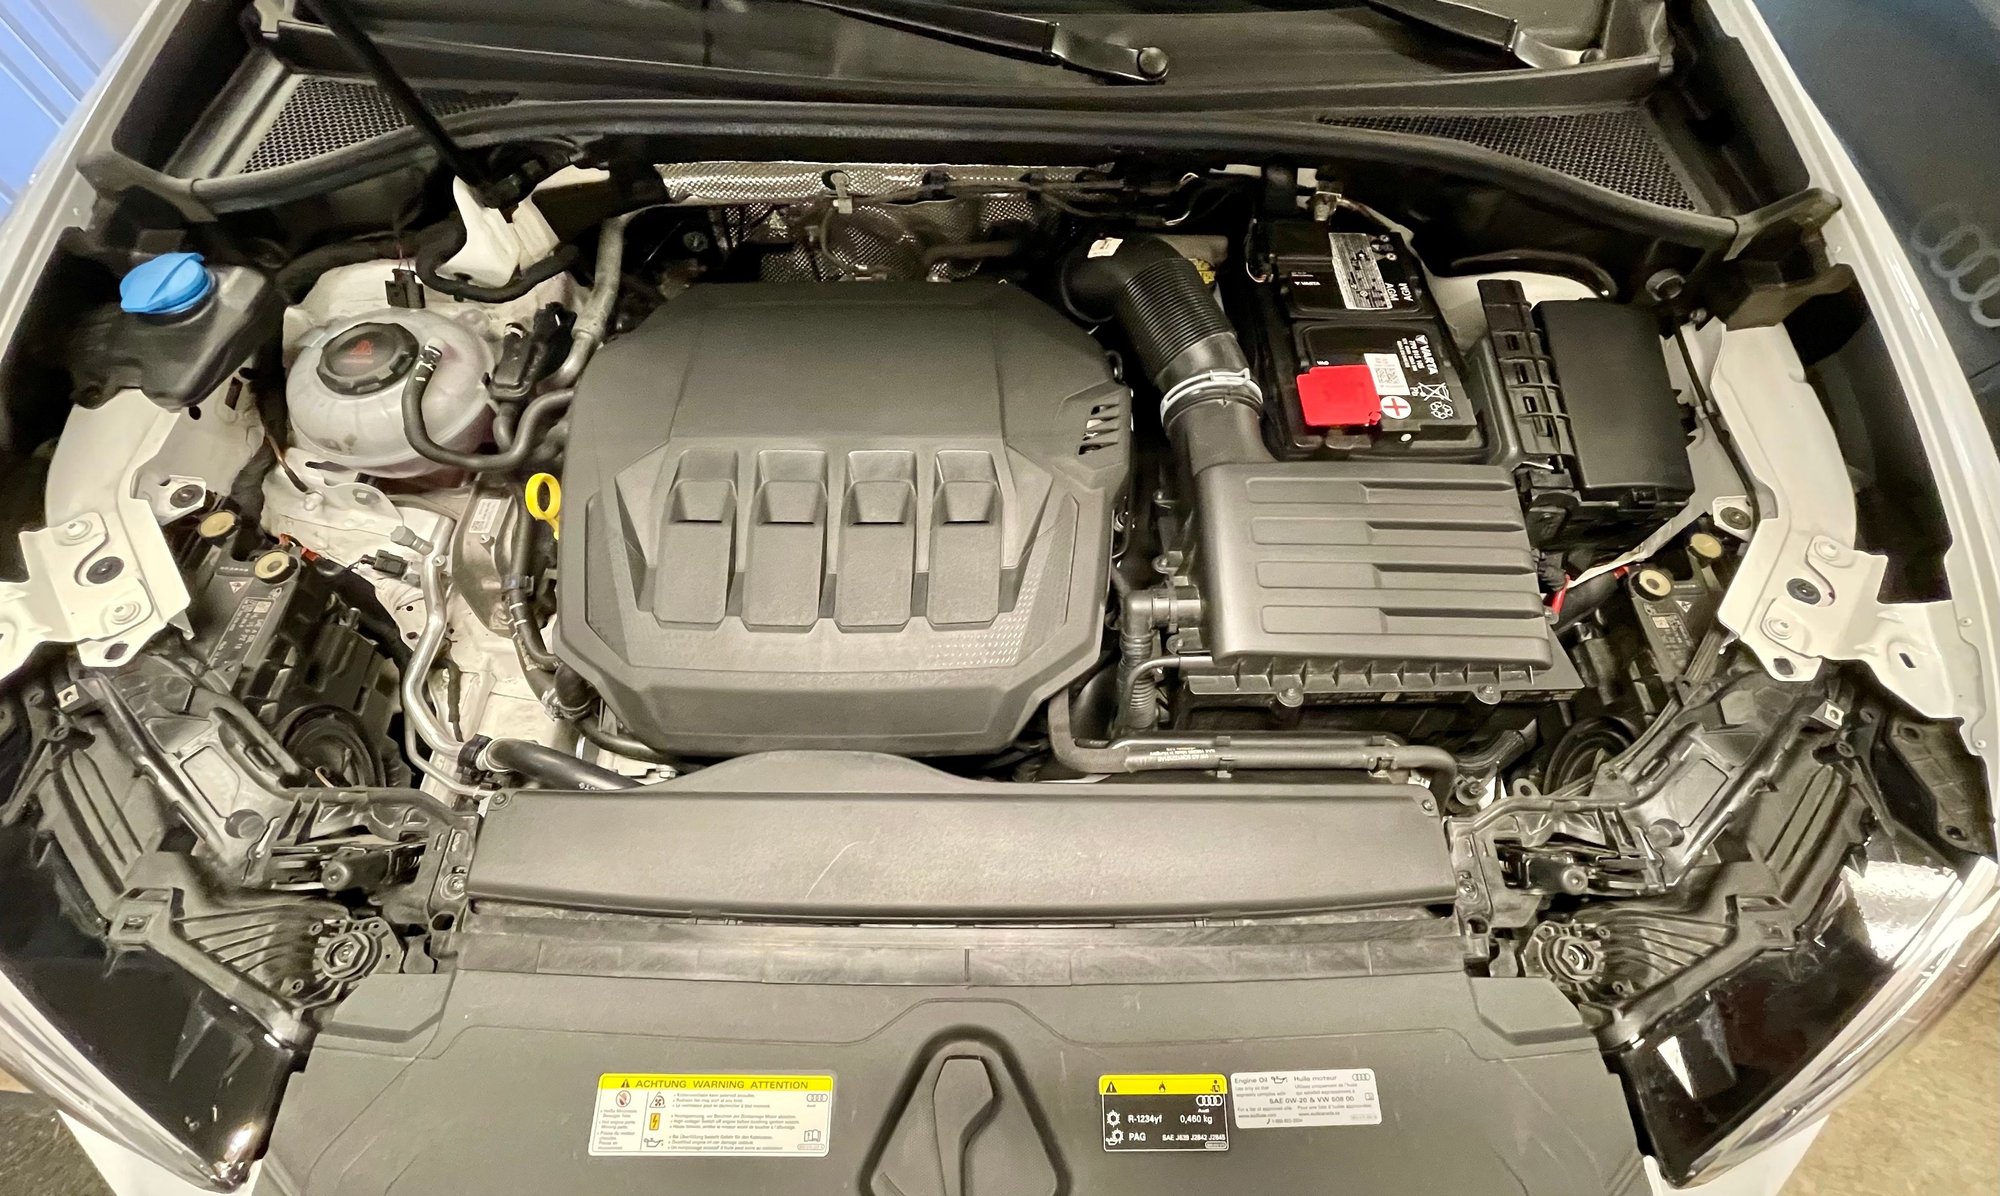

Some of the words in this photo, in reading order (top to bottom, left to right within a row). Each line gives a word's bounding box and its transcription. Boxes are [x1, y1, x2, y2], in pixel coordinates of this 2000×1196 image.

[1385, 282, 1399, 301] AGM
[1398, 282, 1414, 301] AGM
[1420, 345, 1439, 375] VARTA
[635, 1080, 687, 1089] ACHTUNG
[693, 1080, 745, 1090] WARNING
[750, 1081, 809, 1090] ATTENTION
[1127, 1115, 1162, 1124] R-1234yf
[1180, 1115, 1202, 1125] 0,460
[1203, 1114, 1213, 1125] kg
[1128, 1132, 1147, 1142] PAG
[1162, 1134, 1175, 1142] SAE
